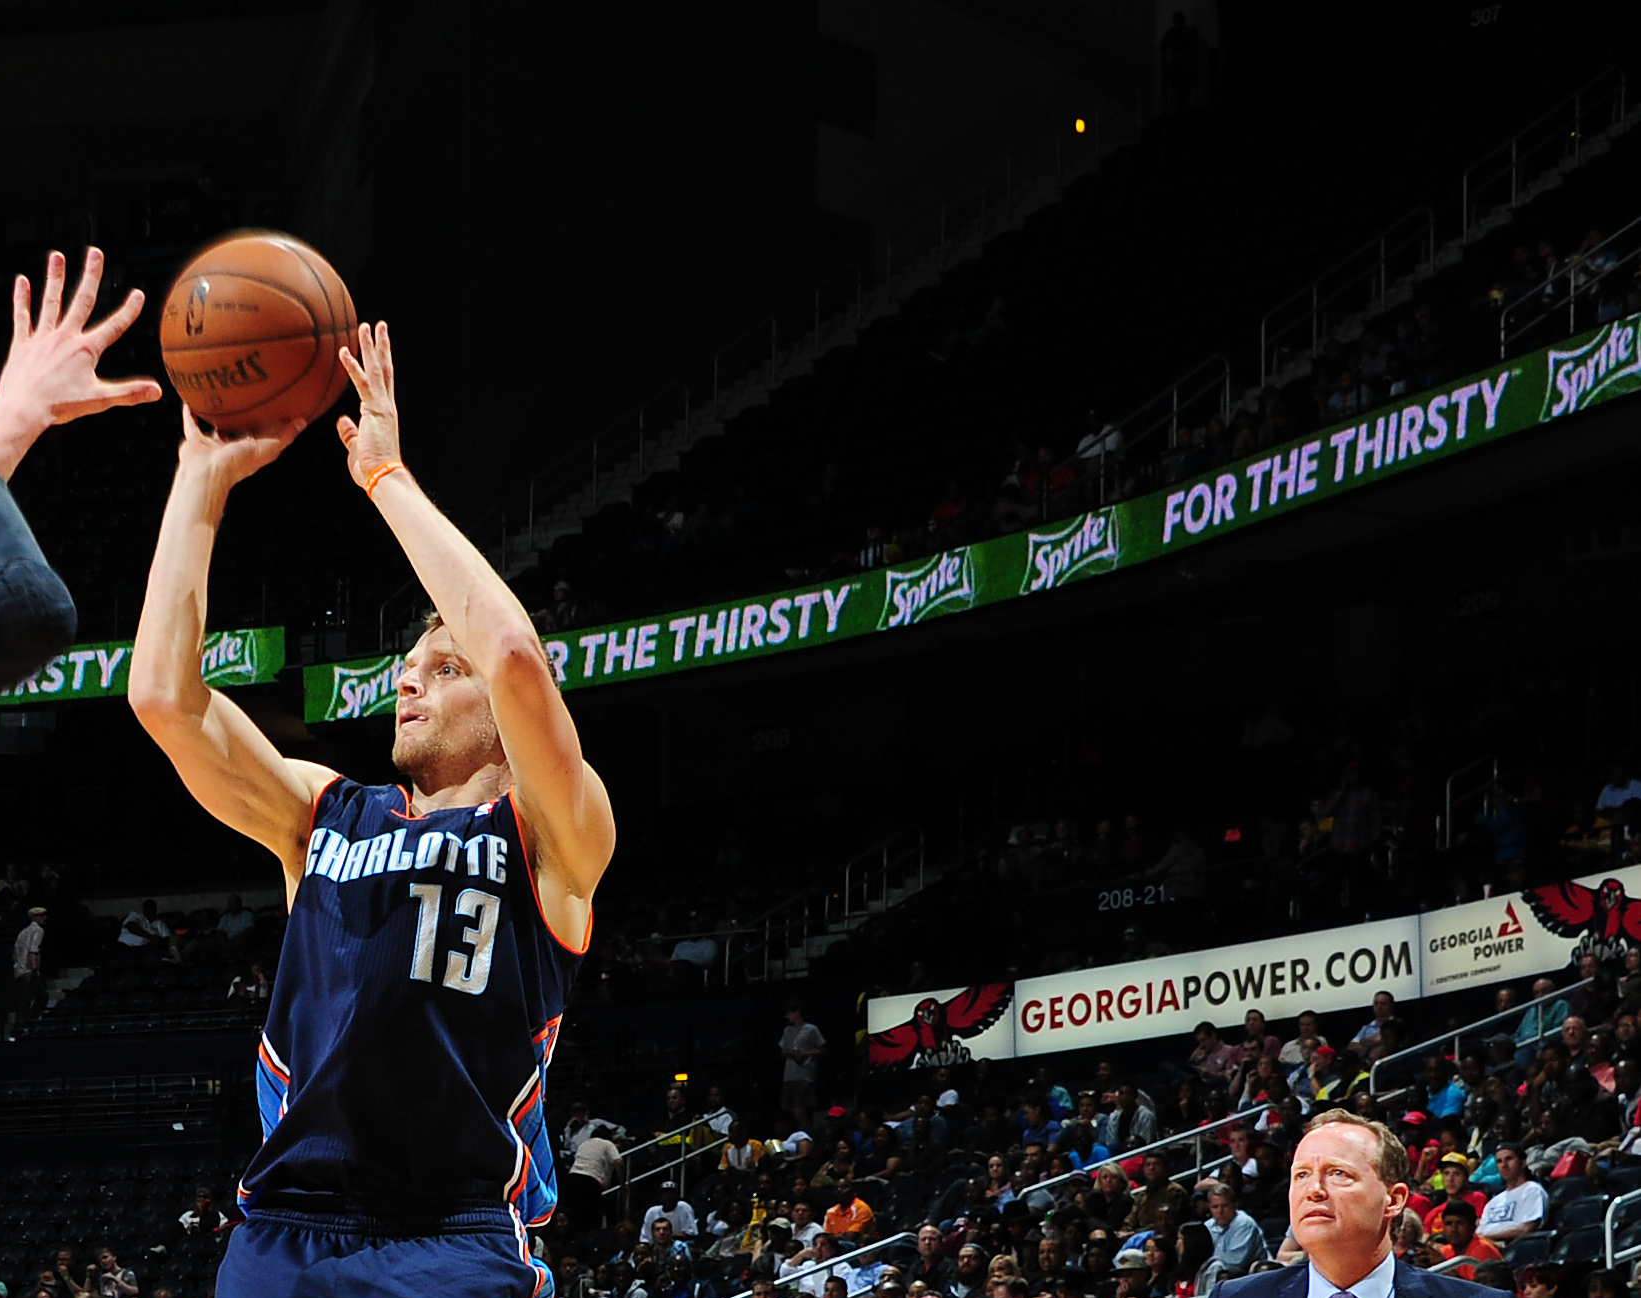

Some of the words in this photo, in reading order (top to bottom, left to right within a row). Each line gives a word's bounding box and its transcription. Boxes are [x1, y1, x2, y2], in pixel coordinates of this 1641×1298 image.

[1551, 321, 1635, 417] Sprite
[1163, 474, 1237, 544] FOR
[1246, 441, 1322, 512] THE
[1031, 512, 1106, 590] Sprite
[888, 552, 960, 628] Sprite
[579, 624, 661, 678] THE
[304, 827, 508, 885] CHARLOTTE
[409, 882, 502, 996] 13
[1429, 926, 1493, 953] GEORGIA
[1473, 937, 1525, 961] POWER
[1020, 941, 1414, 1034] GEORGIAPOWER.COM
